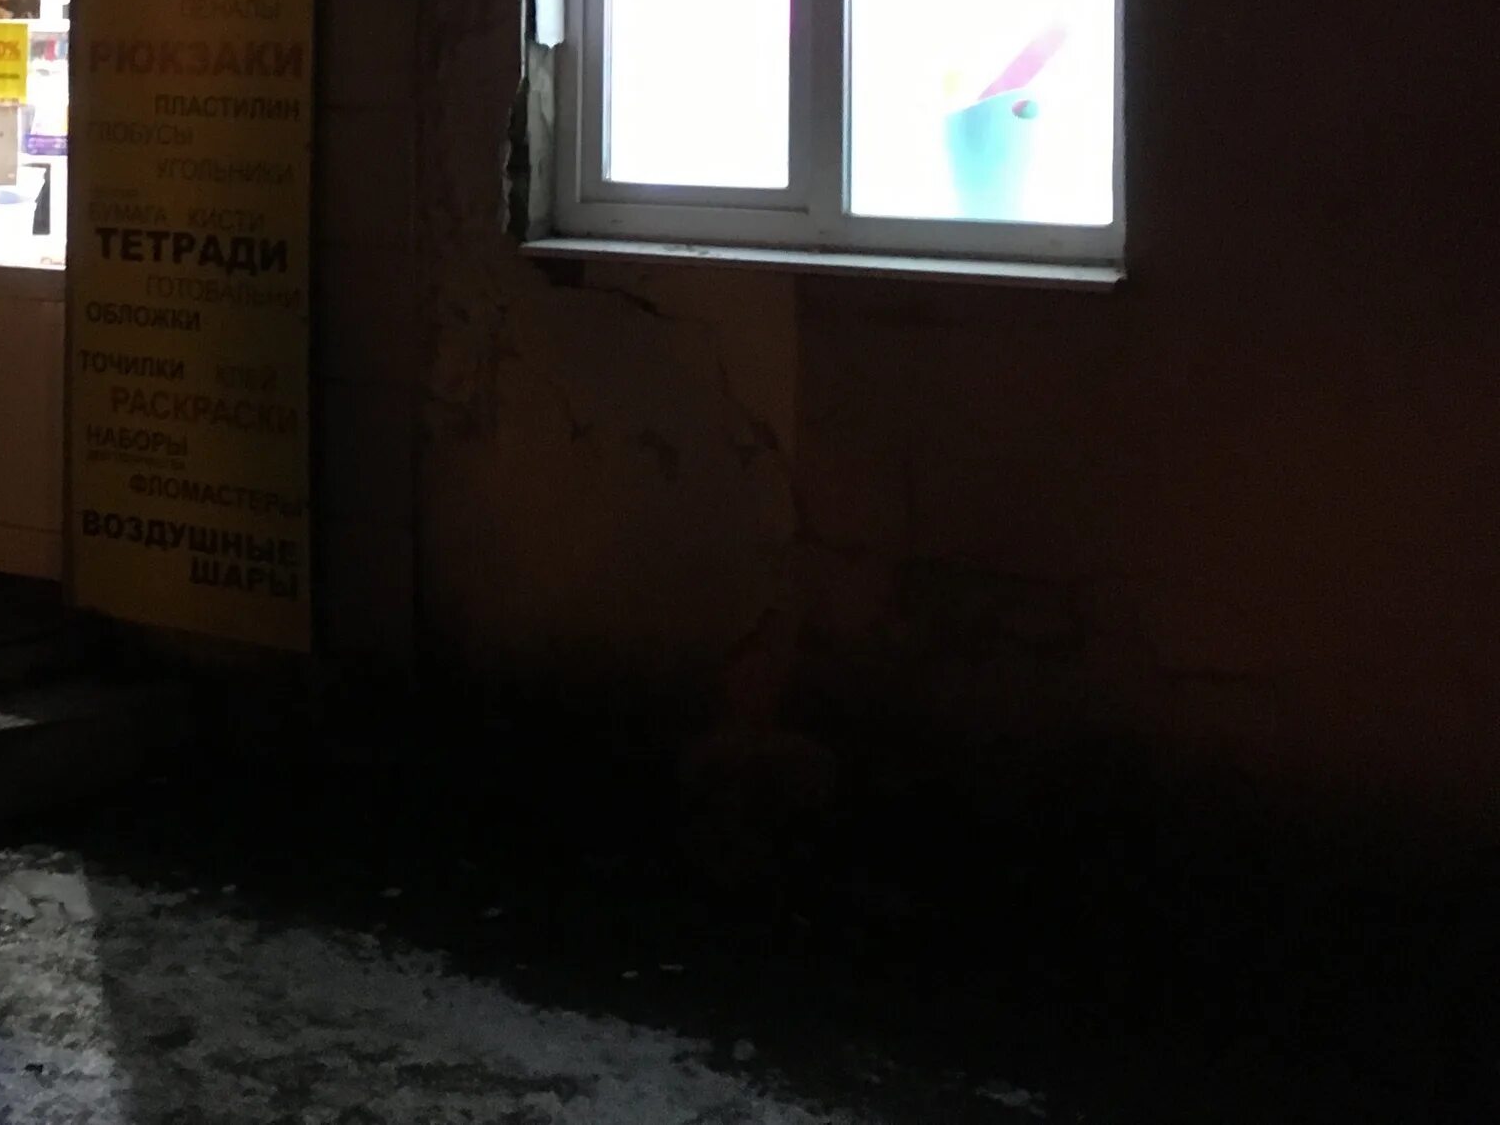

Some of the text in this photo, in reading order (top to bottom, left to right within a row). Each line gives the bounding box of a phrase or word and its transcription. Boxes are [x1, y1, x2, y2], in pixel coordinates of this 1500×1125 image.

[90, 39, 305, 78] РЮКЗАКИ
[153, 94, 301, 121] ПЛАСТИЛИН
[88, 121, 193, 146] ГЛОБУСЫ
[155, 157, 296, 185] УГОЛЬНИКИ
[88, 201, 266, 233] БУМАГА КИСТИ
[95, 227, 289, 276] ТЕТРАДИ
[145, 275, 302, 309] ГОТОВАЛЬНИ
[85, 301, 201, 332] ОБЛОЖКИ
[78, 349, 185, 380] ТОЧИЛКИ
[109, 386, 299, 435] РАСКРАСКИ
[85, 424, 189, 457] НАБОРЫ
[129, 473, 306, 517] ФЛОМАСТЕРЫ
[82, 509, 300, 569] ВОЗДУШНЫЕ
[189, 556, 299, 602] ШАРЫ
